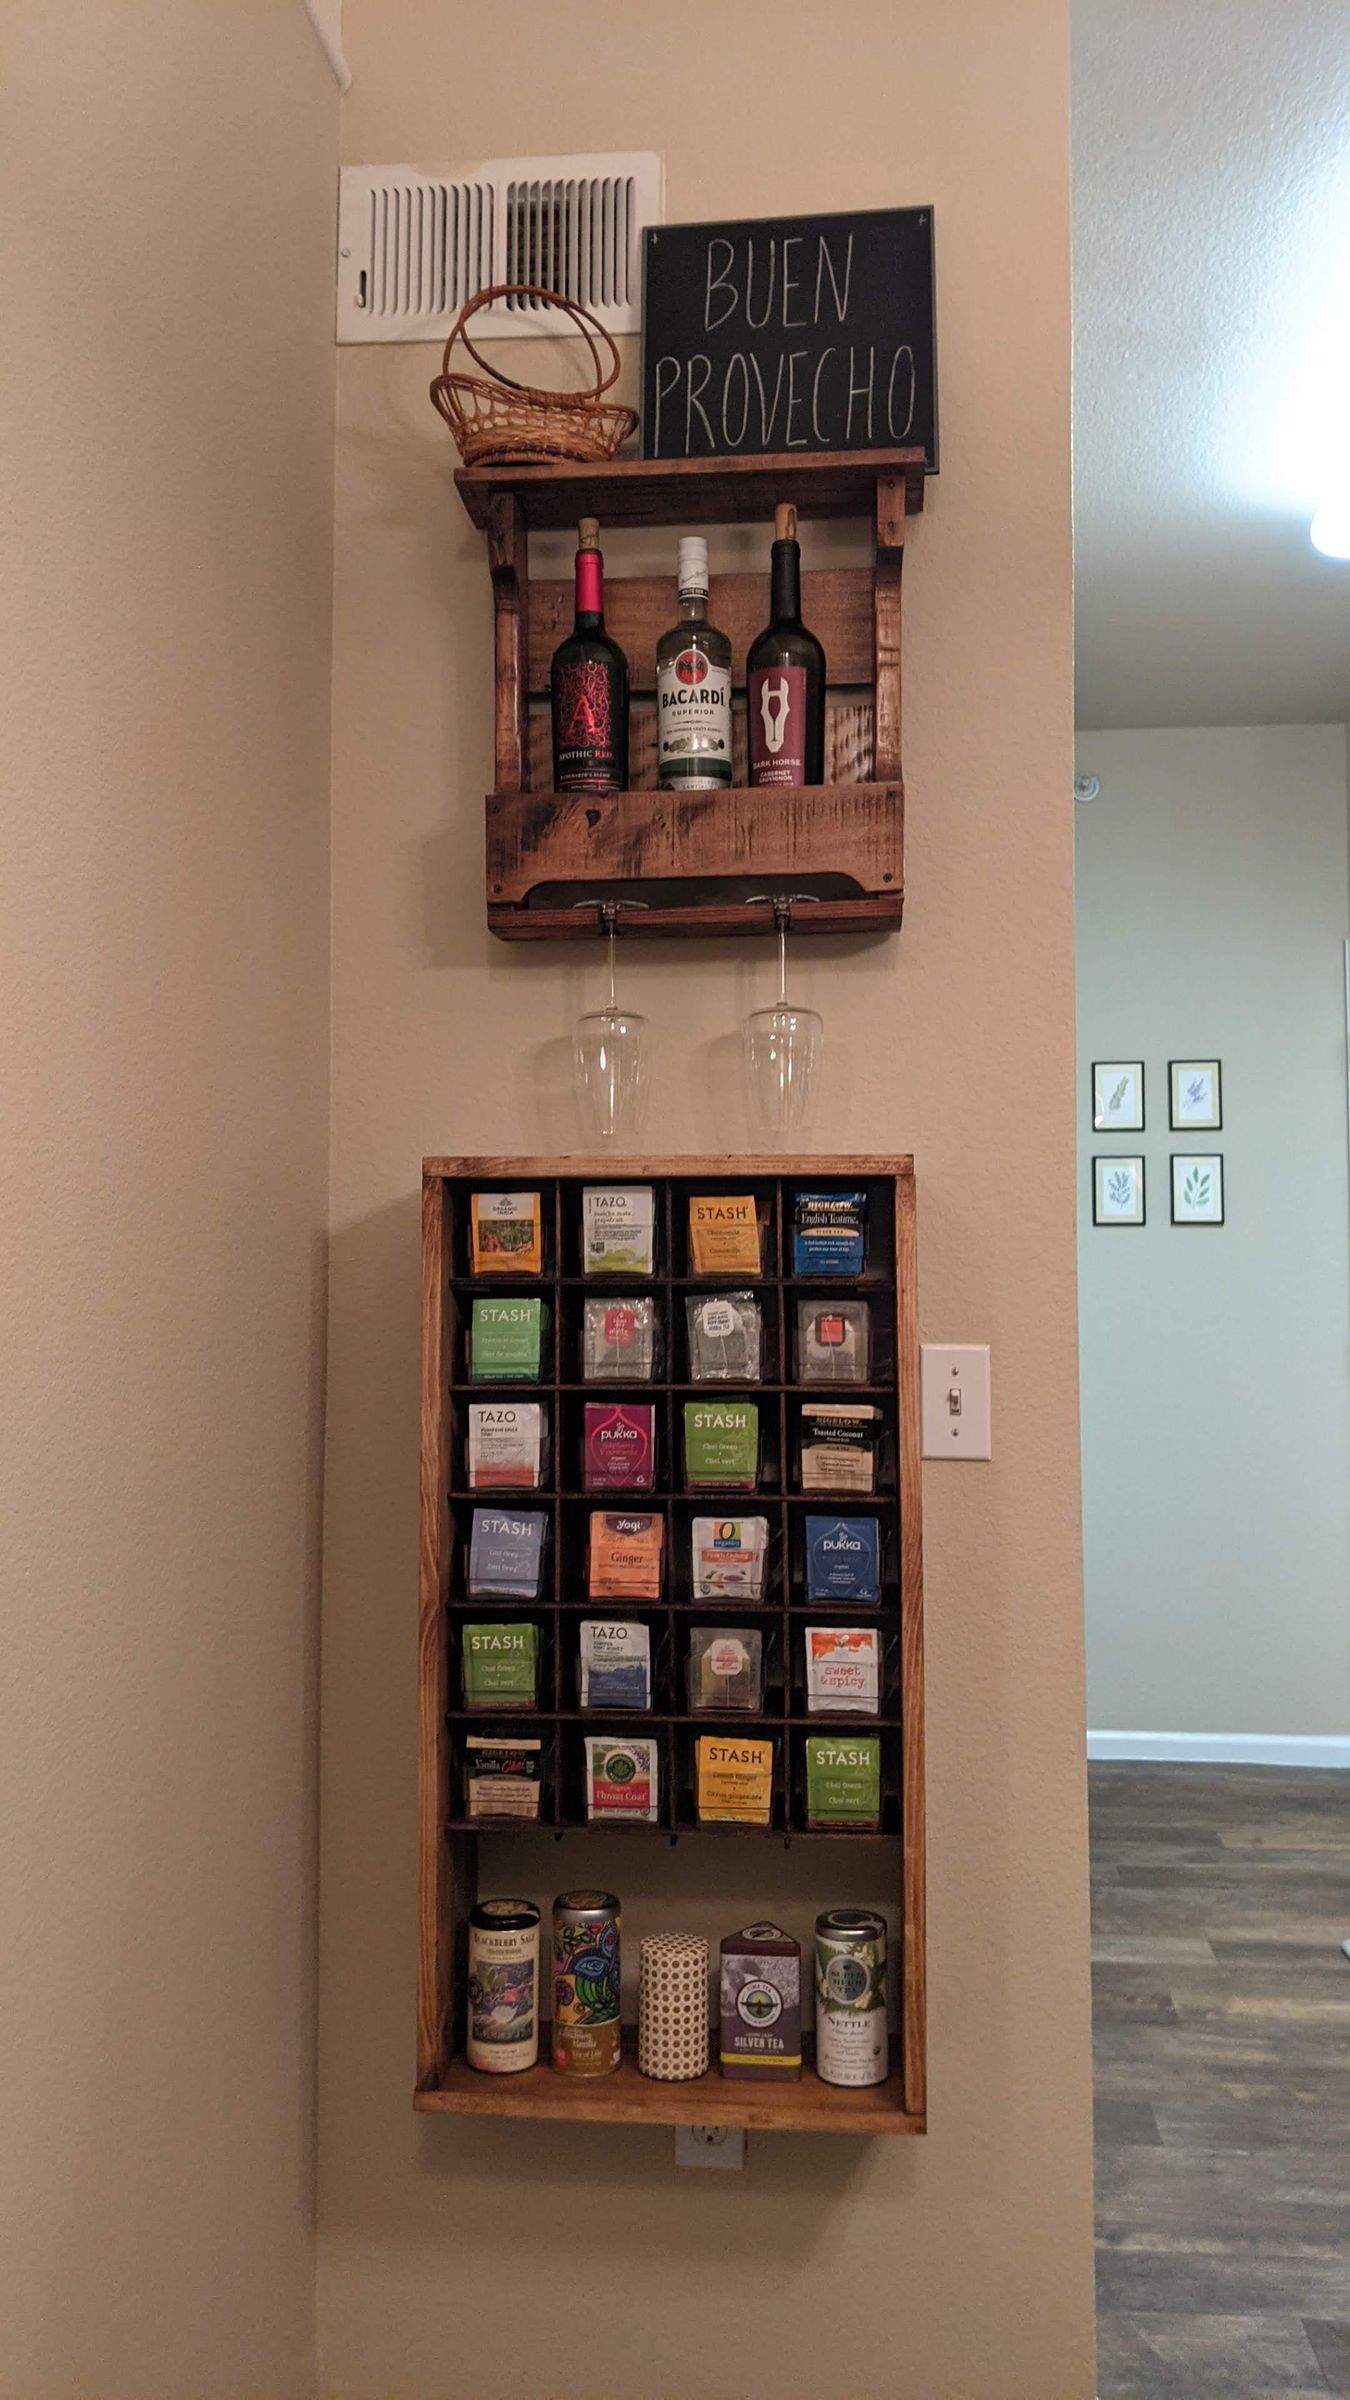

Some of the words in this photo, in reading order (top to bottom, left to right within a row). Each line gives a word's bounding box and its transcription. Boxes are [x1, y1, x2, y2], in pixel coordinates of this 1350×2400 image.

[704, 233, 853, 332] BUEN
[653, 344, 916, 458] PROVECHO
[662, 687, 725, 709] BACARDÍ
[672, 709, 714, 717] SUPERIOR
[559, 750, 593, 760] APOTHIC
[594, 750, 613, 759] RED
[772, 758, 801, 766] HORSE
[759, 775, 793, 783] SAUVIGNON
[594, 1197, 626, 1208] TAZO
[697, 1207, 747, 1220] STASH
[801, 1213, 828, 1225] English
[479, 1309, 531, 1323] STASH
[478, 1411, 516, 1423] TAZO
[694, 1414, 746, 1428] STASH
[601, 1429, 638, 1442] pukka
[837, 1429, 864, 1438] Coconut
[481, 1519, 532, 1536] STASH
[617, 1518, 641, 1531] yogi
[823, 1540, 861, 1551] pukka
[611, 1551, 644, 1565] Ginger
[590, 1626, 628, 1639] TAZO
[471, 1636, 524, 1650] STASH
[825, 1665, 861, 1676] sweet
[829, 1676, 865, 1689] spicy
[709, 1747, 762, 1764] STASH
[816, 1751, 870, 1766] STASH
[475, 1759, 500, 1769] Vanilla
[596, 1790, 623, 1800] Throat
[625, 1791, 646, 1801] Coat
[474, 1933, 517, 1946] BLACKBERRY
[828, 2016, 872, 2028] NETTLE
[734, 2036, 765, 2048] SILVER
[767, 2038, 785, 2049] TEA
